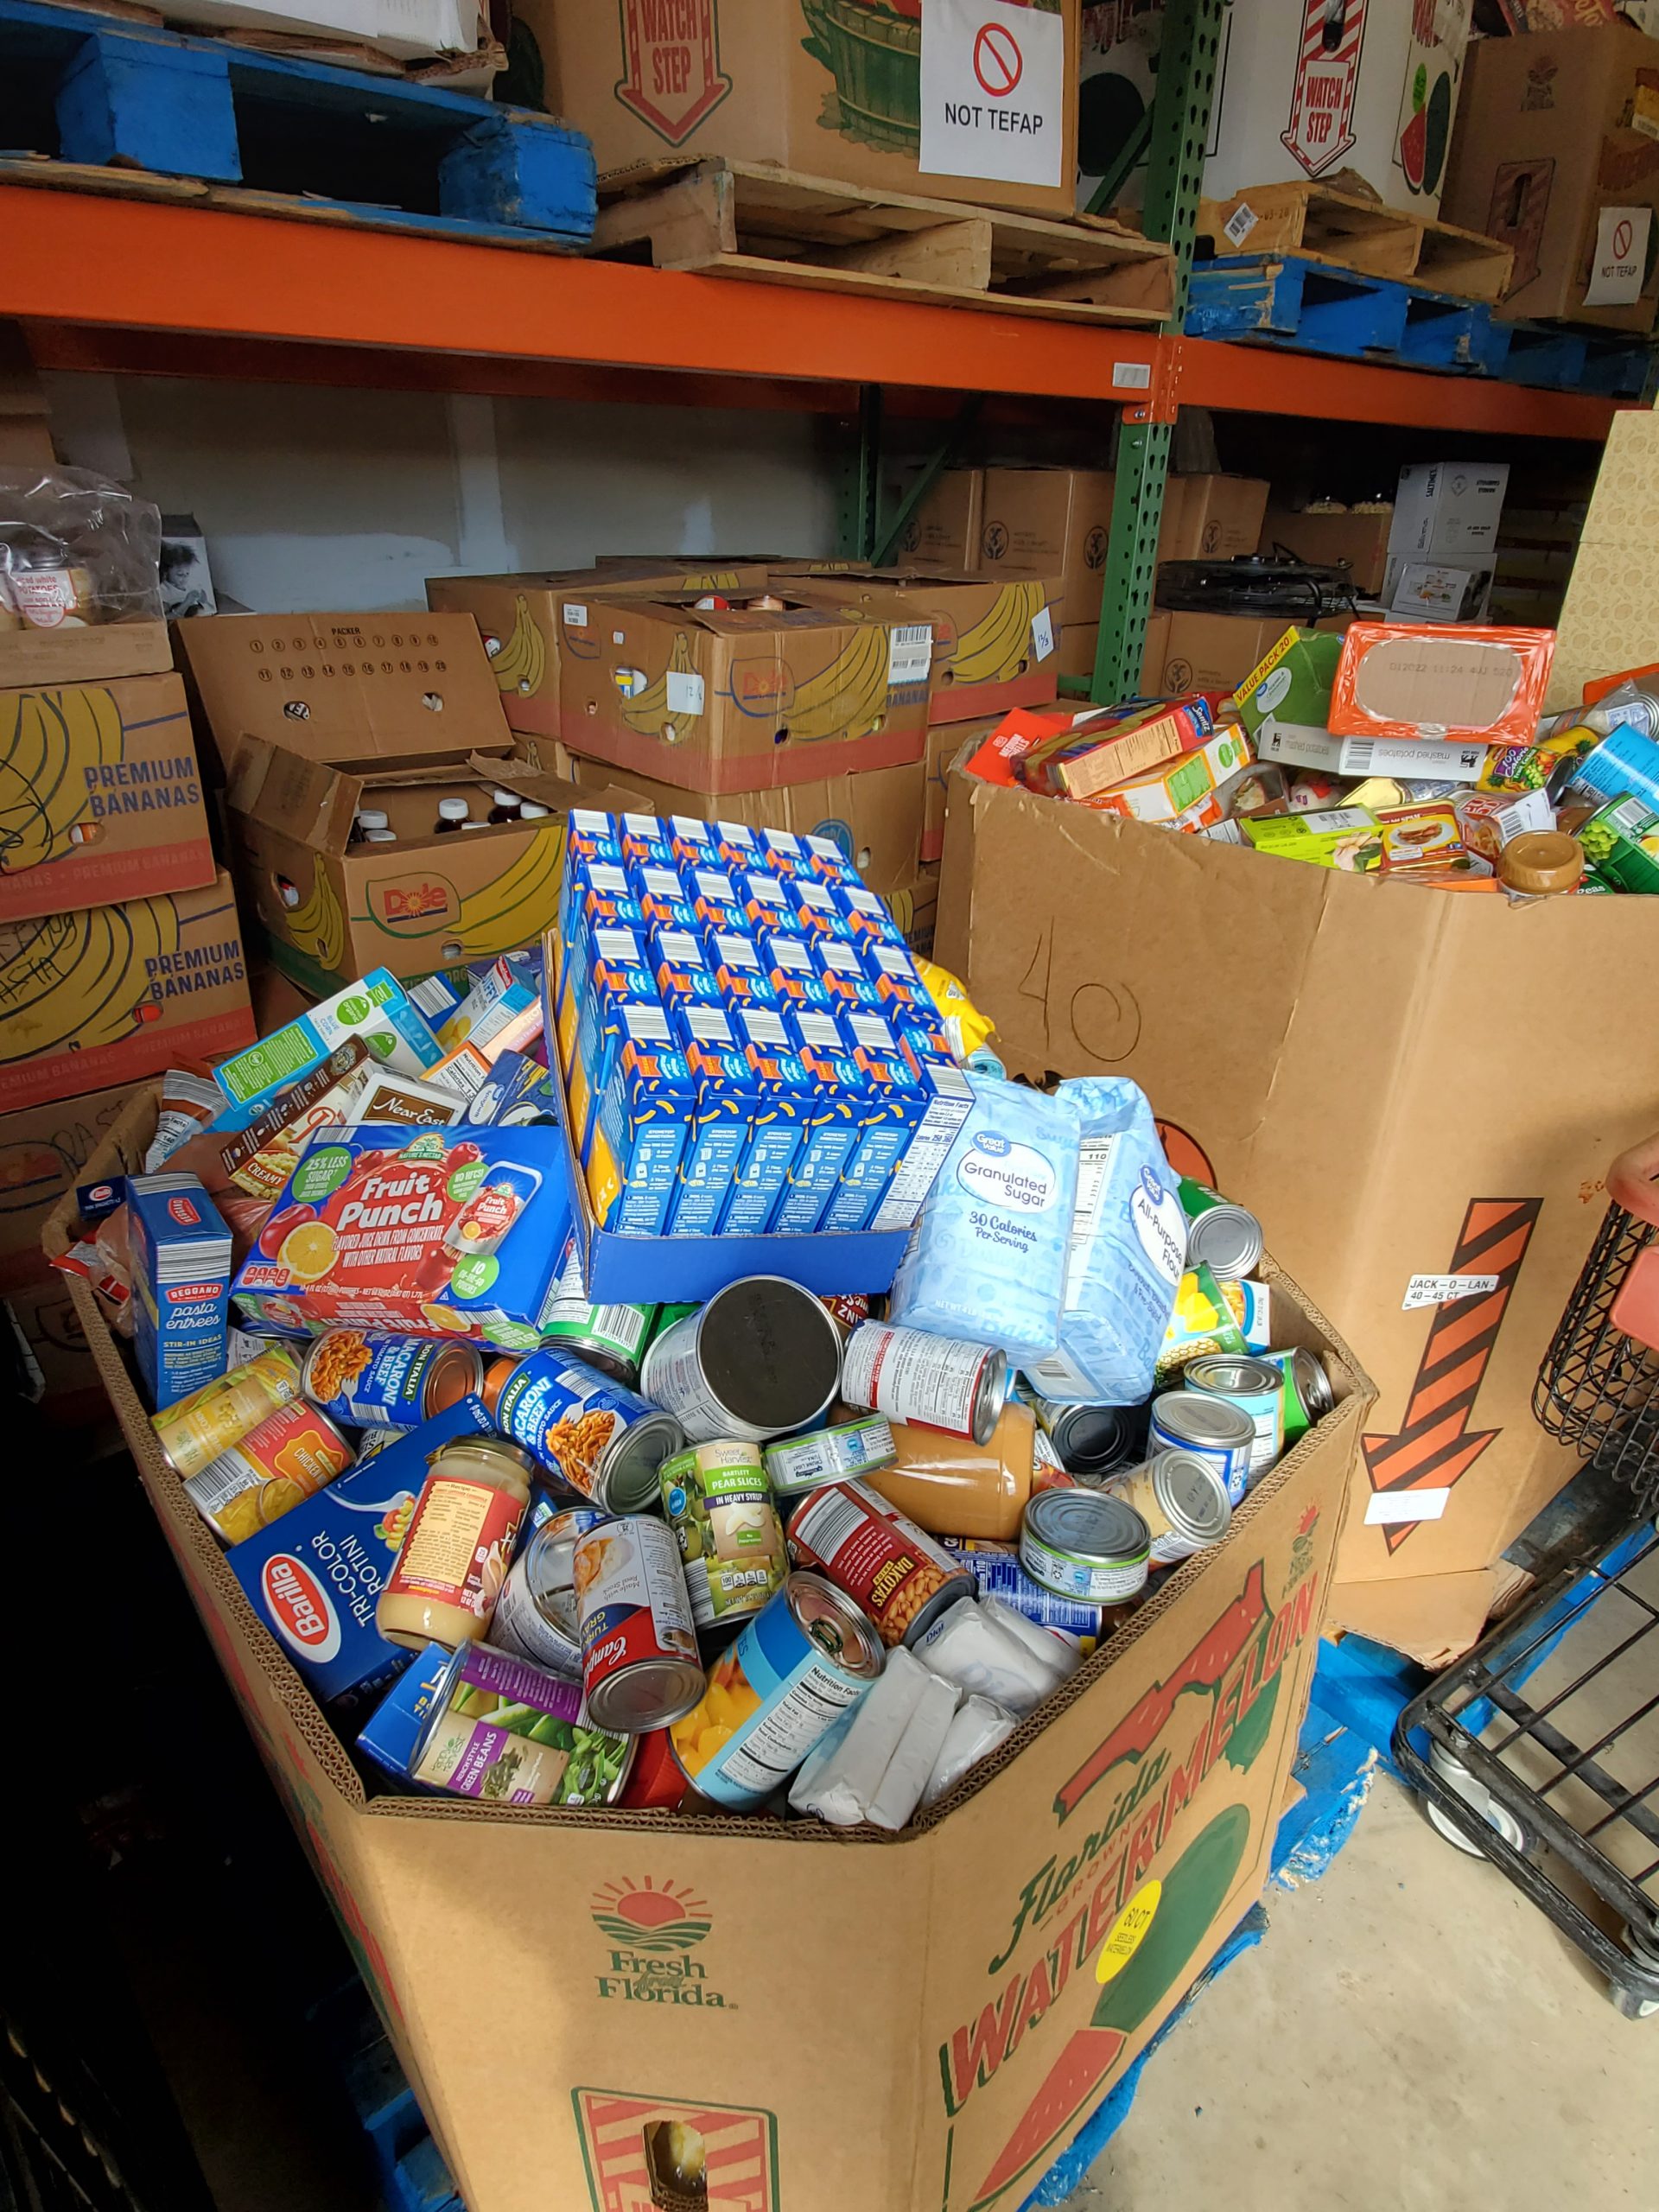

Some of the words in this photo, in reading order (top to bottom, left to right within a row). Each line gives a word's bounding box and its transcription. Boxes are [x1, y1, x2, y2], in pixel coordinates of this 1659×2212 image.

[640, 0, 697, 42] WATCH
[652, 47, 691, 94] STEP
[1306, 76, 1343, 109] WATCH
[945, 102, 982, 128] NOT
[988, 109, 1043, 135] TEFAP
[1306, 111, 1332, 143] STEP
[1236, 677, 1259, 702] VALUE
[1259, 649, 1280, 677] PACK
[1279, 636, 1290, 652] 20
[999, 734, 1023, 757] MEDIUM
[1378, 747, 1412, 760] potatoes
[1414, 748, 1451, 761] mashed
[1502, 749, 1516, 768] 100
[84, 757, 194, 789] PREMIUM
[90, 783, 200, 817] BANANAS
[384, 883, 448, 915] Dole
[145, 940, 239, 977] PREMIUM
[150, 962, 245, 1000] BANANAS
[481, 975, 499, 1004] JIFFY
[446, 1065, 464, 1089] Calories
[462, 1053, 481, 1077] Nutrition
[373, 1097, 417, 1119] Near
[416, 1109, 446, 1125] East
[934, 1099, 956, 1108] Nutrition
[977, 1133, 1006, 1149] Great
[983, 1143, 1005, 1154] Value
[247, 1162, 284, 1185] CREAMY
[305, 1157, 328, 1171] 25%
[327, 1156, 348, 1168] LESS
[360, 1173, 430, 1200] Fruit
[964, 1162, 1047, 1195] Granulated
[477, 1202, 507, 1214] Punch
[484, 1196, 507, 1205] Fruit
[1005, 1185, 1046, 1207] Sugar
[336, 1192, 443, 1231] Punch
[391, 1229, 410, 1244] FROM
[969, 1211, 988, 1226] 30
[990, 1216, 1038, 1243] Calories
[976, 1226, 993, 1240] Per
[992, 1231, 1030, 1253] Serving
[1137, 1198, 1183, 1266] All-Purpose
[342, 1251, 358, 1268] WITH
[357, 1249, 377, 1267] OTHER
[397, 1244, 423, 1262] FLAVORS
[472, 1260, 486, 1274] 10
[1162, 1247, 1180, 1282] Flour
[171, 1286, 219, 1299] REGGANO
[935, 1299, 950, 1309] NET
[1446, 1290, 1460, 1300] CT
[166, 1314, 221, 1330] entrees
[170, 1302, 218, 1320] pasta
[199, 1333, 222, 1345] IDEAS
[419, 1344, 434, 1361] BON
[372, 1344, 388, 1369] TOMATO
[363, 1370, 377, 1394] SAUCE
[374, 1355, 396, 1388] BEEF
[381, 1338, 421, 1407] MACARONI
[405, 1361, 424, 1396] ITALIA
[504, 1377, 527, 1414] ITALIA
[503, 1413, 512, 1434] BON
[514, 1376, 553, 1446] ACARONI
[526, 1400, 548, 1435] BEEF
[537, 1421, 547, 1451] TOMATO
[543, 1398, 563, 1421] SAUCE
[294, 1446, 323, 1478] CHICKEN
[715, 1448, 741, 1459] Sweet
[720, 1453, 753, 1465] Harvest
[450, 1483, 472, 1493] Recipe
[712, 1479, 736, 1491] PEAR
[737, 1478, 763, 1489] SLICES
[715, 1496, 724, 1505] IN
[724, 1494, 747, 1504] HEAVY
[746, 1491, 764, 1503] SYRUP
[338, 1534, 385, 1596] ROTINI
[873, 1560, 894, 1586] PRIDE
[311, 1530, 376, 1628] TRI-COLOR
[871, 1556, 915, 1608] DAKOTA'S
[270, 1561, 326, 1637] Barilla
[925, 1623, 944, 1643] Dial
[810, 1666, 844, 1693] Nutrition
[456, 1759, 472, 1782] FRENCH
[467, 1741, 481, 1762] STYLE
[461, 1768, 480, 1791] GREEN
[475, 1731, 498, 1770] BEANS
[940, 1570, 1319, 2118] WATERMELON
[988, 1747, 1172, 1976] Florida
[1057, 1821, 1131, 1915] GROWN
[607, 1949, 709, 1980] Fresh
[594, 1975, 727, 2008] Florida
